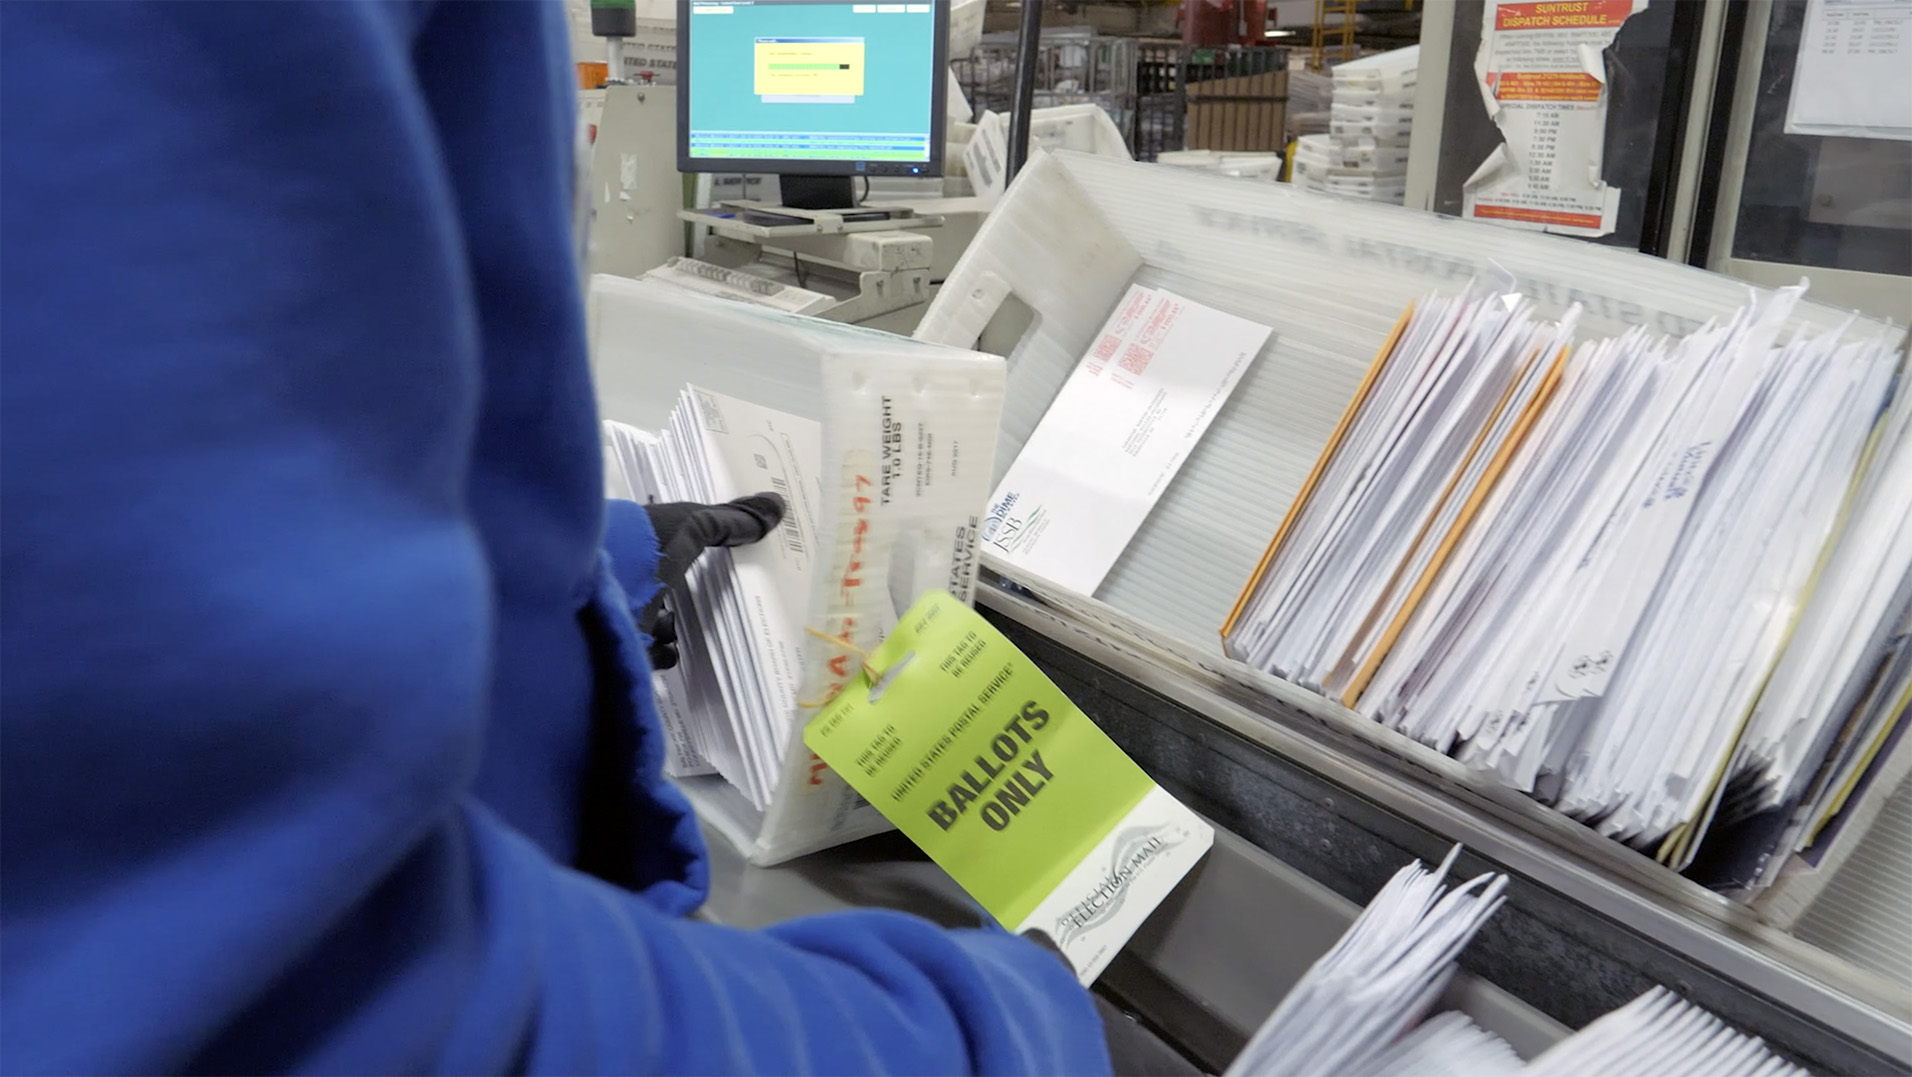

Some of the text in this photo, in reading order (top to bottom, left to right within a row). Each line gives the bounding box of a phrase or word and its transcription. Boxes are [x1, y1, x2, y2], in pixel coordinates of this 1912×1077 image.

[1503, 14, 1607, 27] DISPATCH SCHEDULE
[1535, 2, 1589, 13] SUNTRUST
[881, 396, 892, 506] TARE WEIGHT
[892, 422, 902, 479] 1.0 LBS
[995, 491, 1016, 518] DIME
[958, 515, 978, 602] SERVICE
[938, 631, 978, 673] THIS TAG TO
[950, 639, 988, 678] BE REUSED
[855, 724, 896, 769] THIS TAG TO
[864, 736, 904, 778] BE REUSED
[891, 767, 926, 804] UNITED
[919, 735, 955, 771] STATES
[947, 701, 985, 740] POSTAL
[928, 699, 1051, 832] BALLOTS
[978, 750, 1056, 832] ONLY
[1072, 864, 1134, 929] ELECTION
[1131, 836, 1162, 868] MAIL
